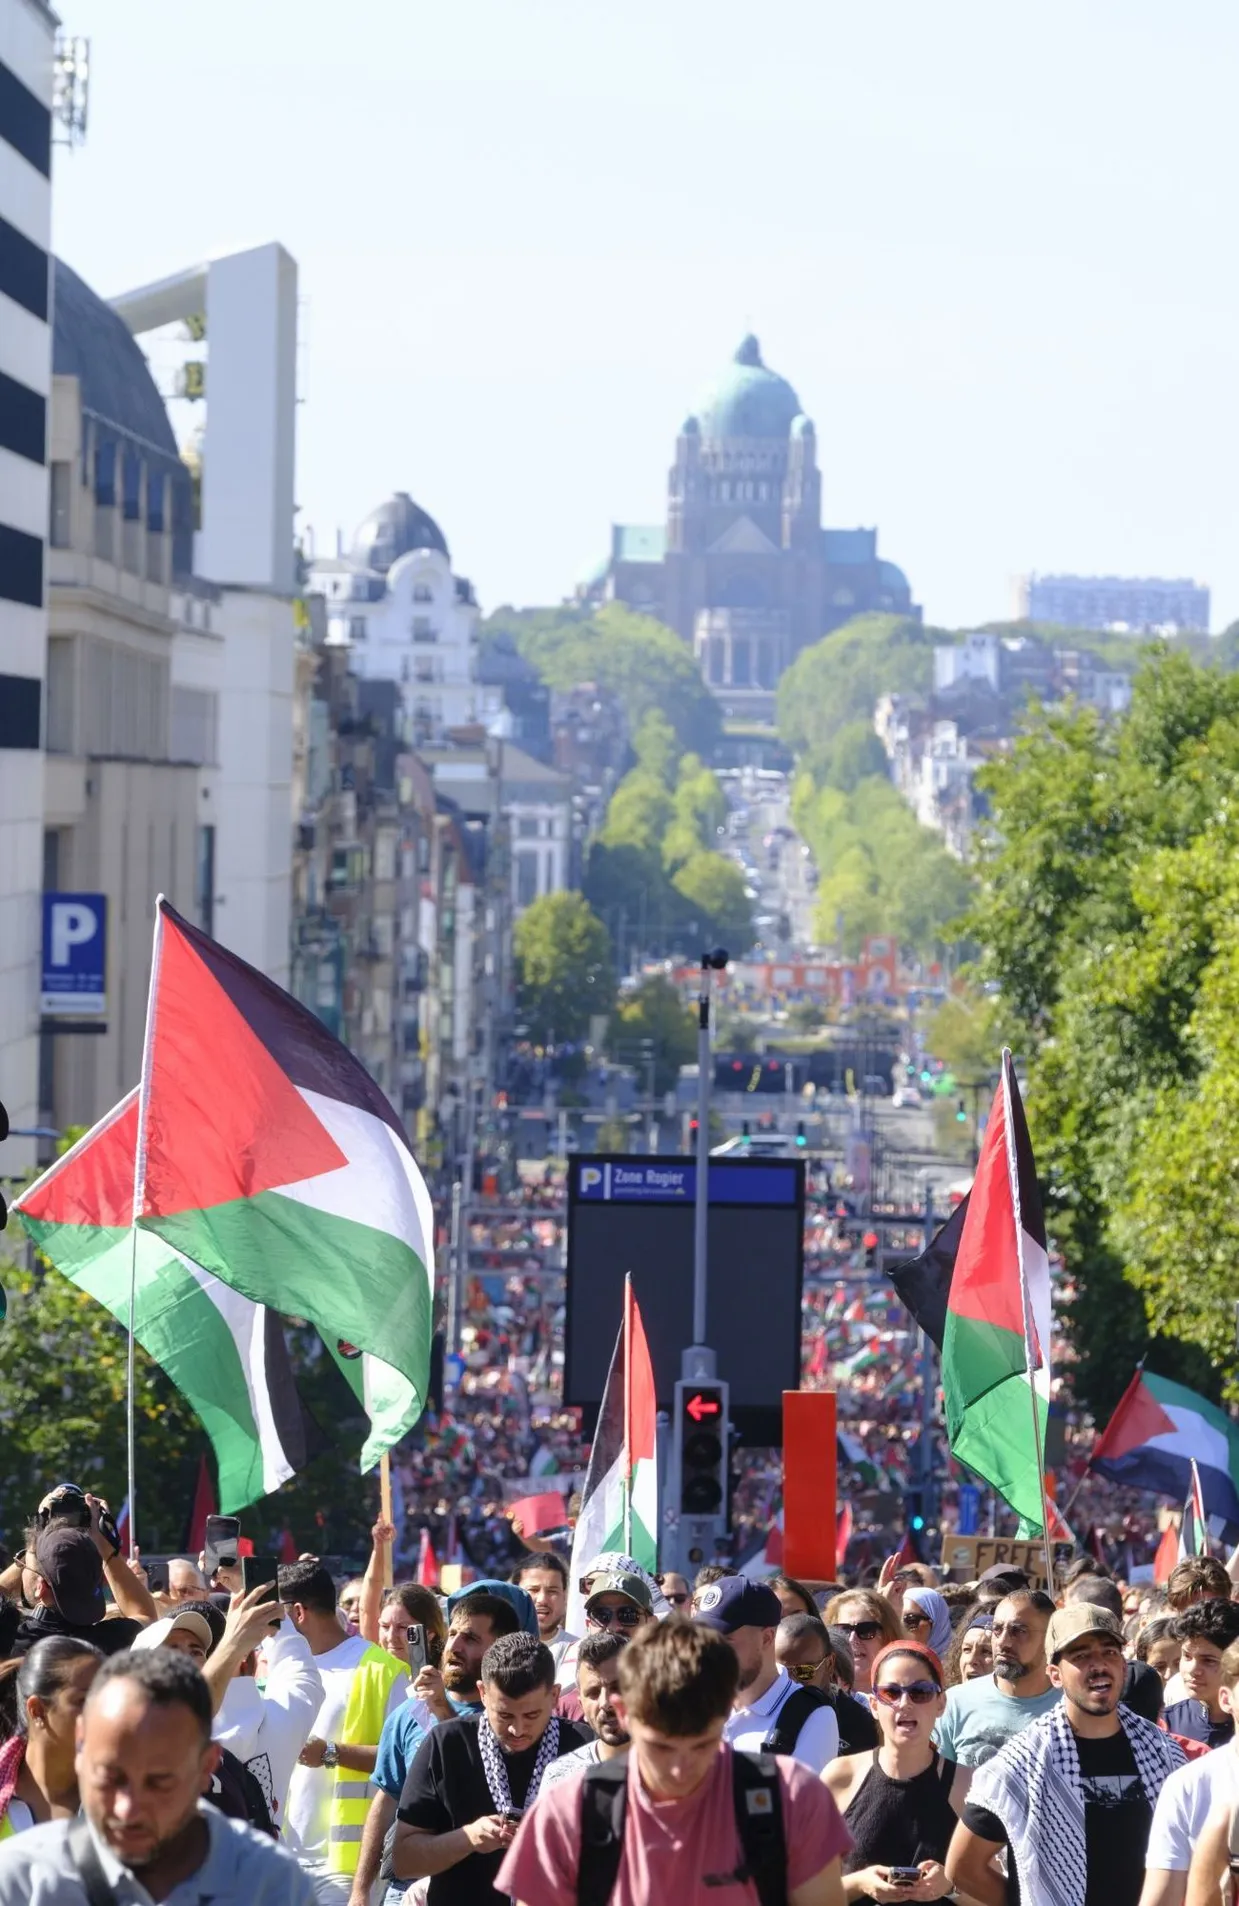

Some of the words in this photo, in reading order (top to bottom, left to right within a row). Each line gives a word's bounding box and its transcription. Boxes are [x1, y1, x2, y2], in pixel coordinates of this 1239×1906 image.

[51, 902, 97, 967] P
[581, 1167, 601, 1193] P
[614, 1168, 643, 1184] Zone
[646, 1169, 684, 1188] Rogier
[976, 1542, 1042, 1575] FREE
